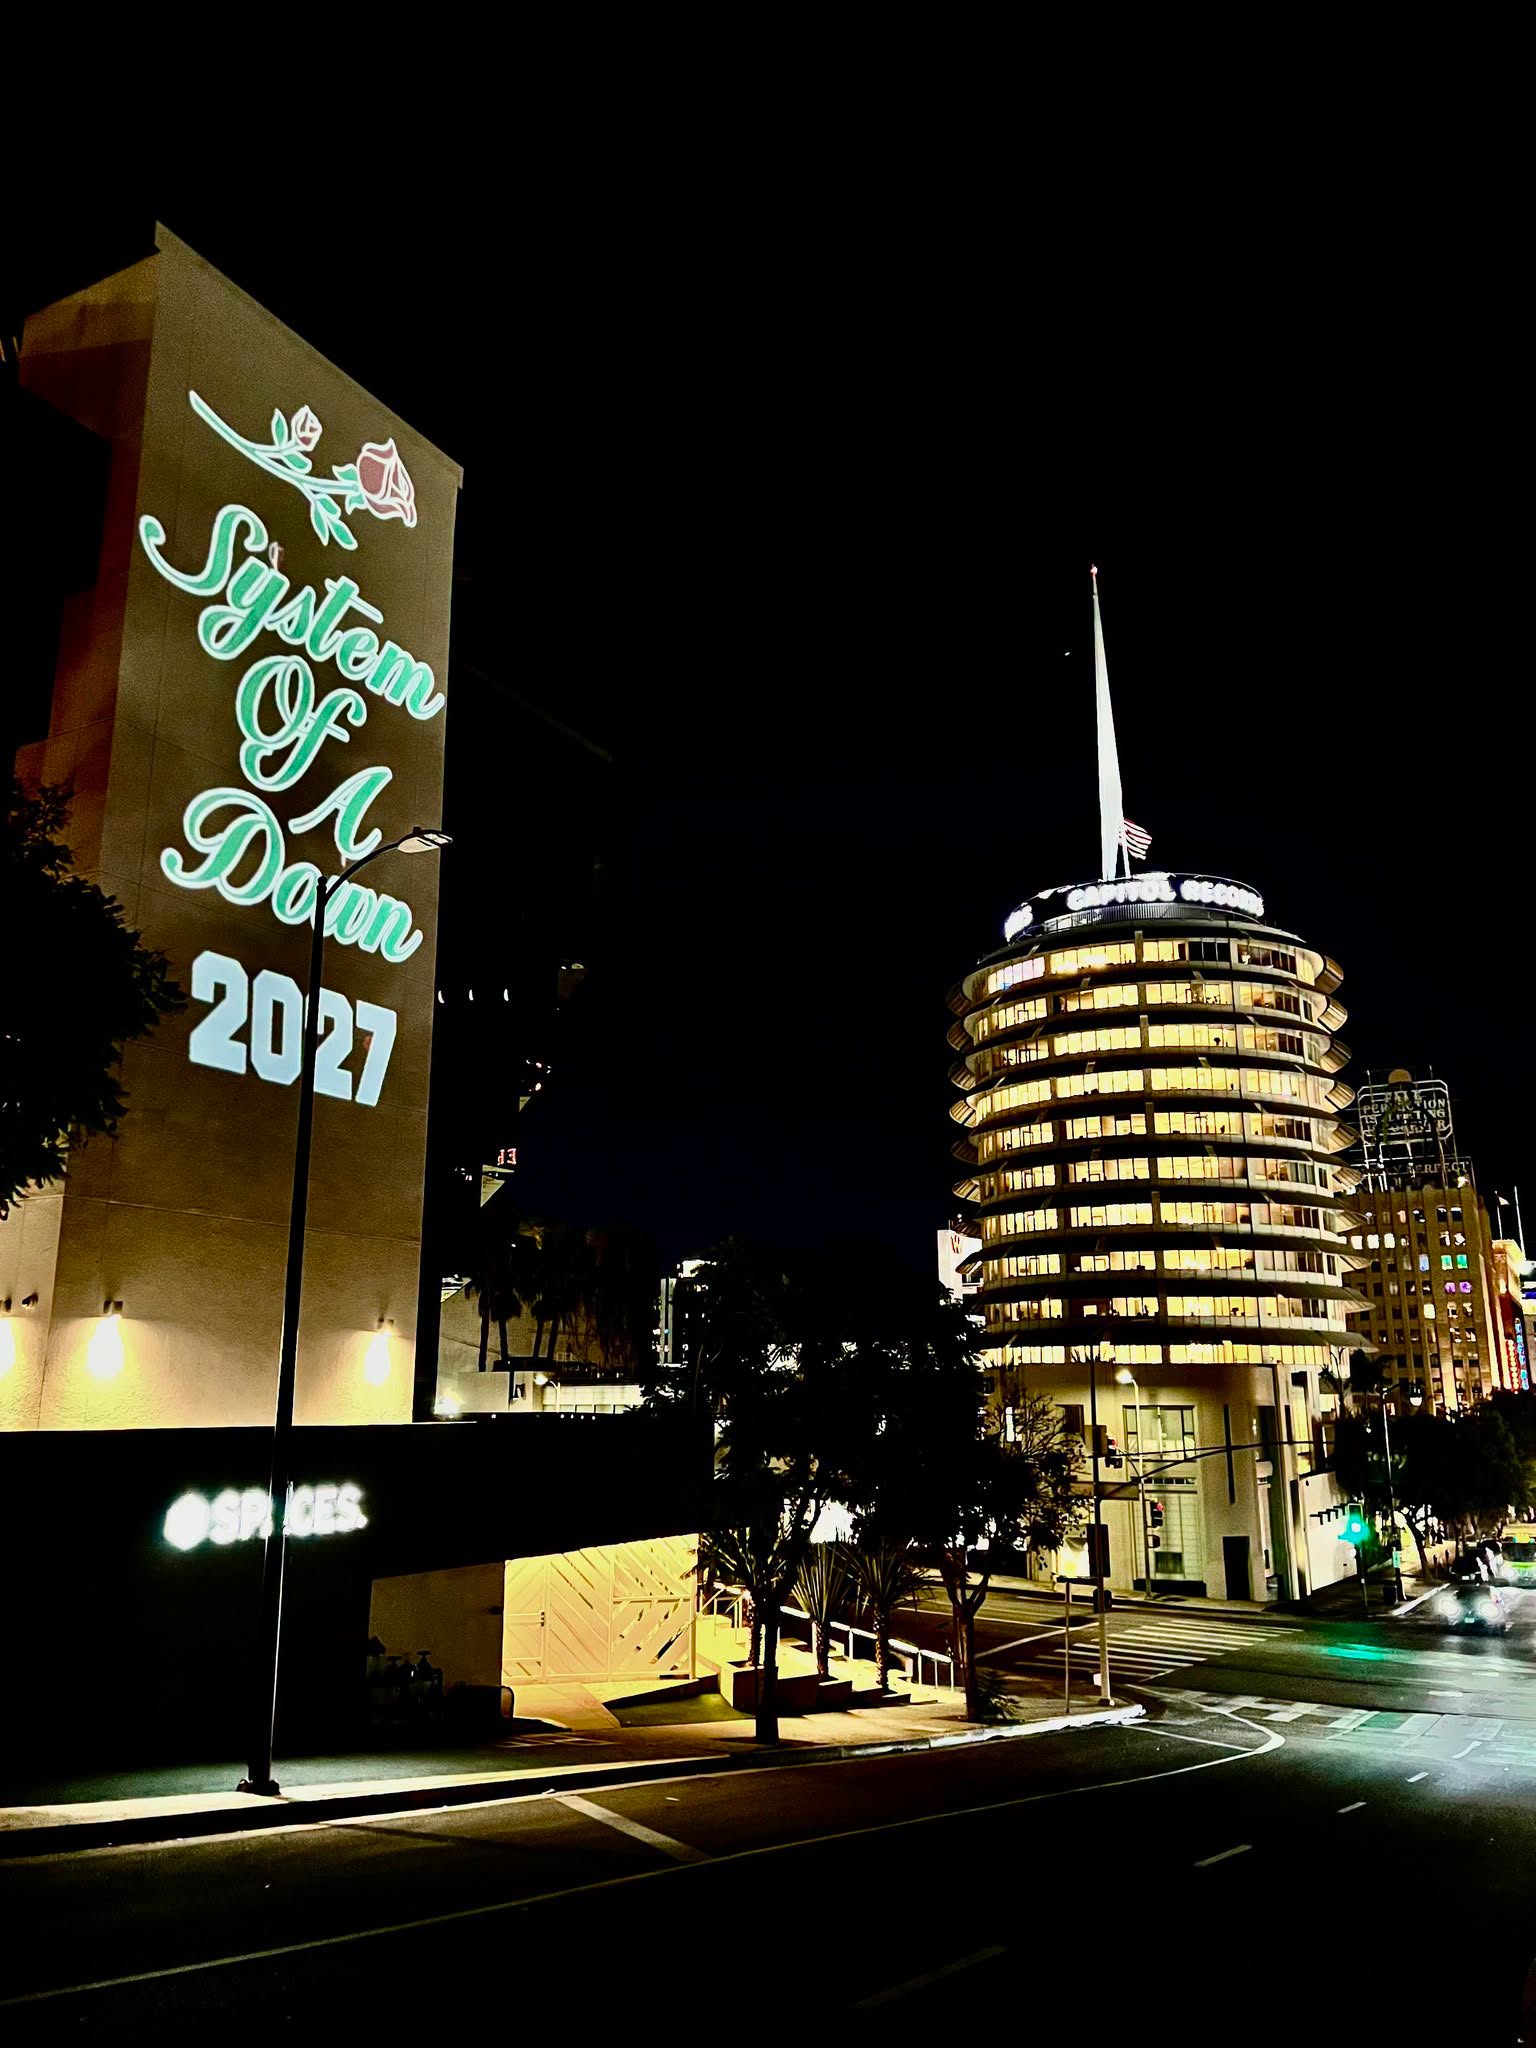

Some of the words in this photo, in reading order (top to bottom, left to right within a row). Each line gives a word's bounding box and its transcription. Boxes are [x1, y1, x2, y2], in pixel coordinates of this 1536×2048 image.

[139, 504, 446, 721] System
[236, 655, 367, 792] Of
[160, 787, 423, 963] Down
[288, 766, 393, 861] A
[1066, 880, 1177, 911] CAPITOL
[189, 950, 397, 1107] 2027
